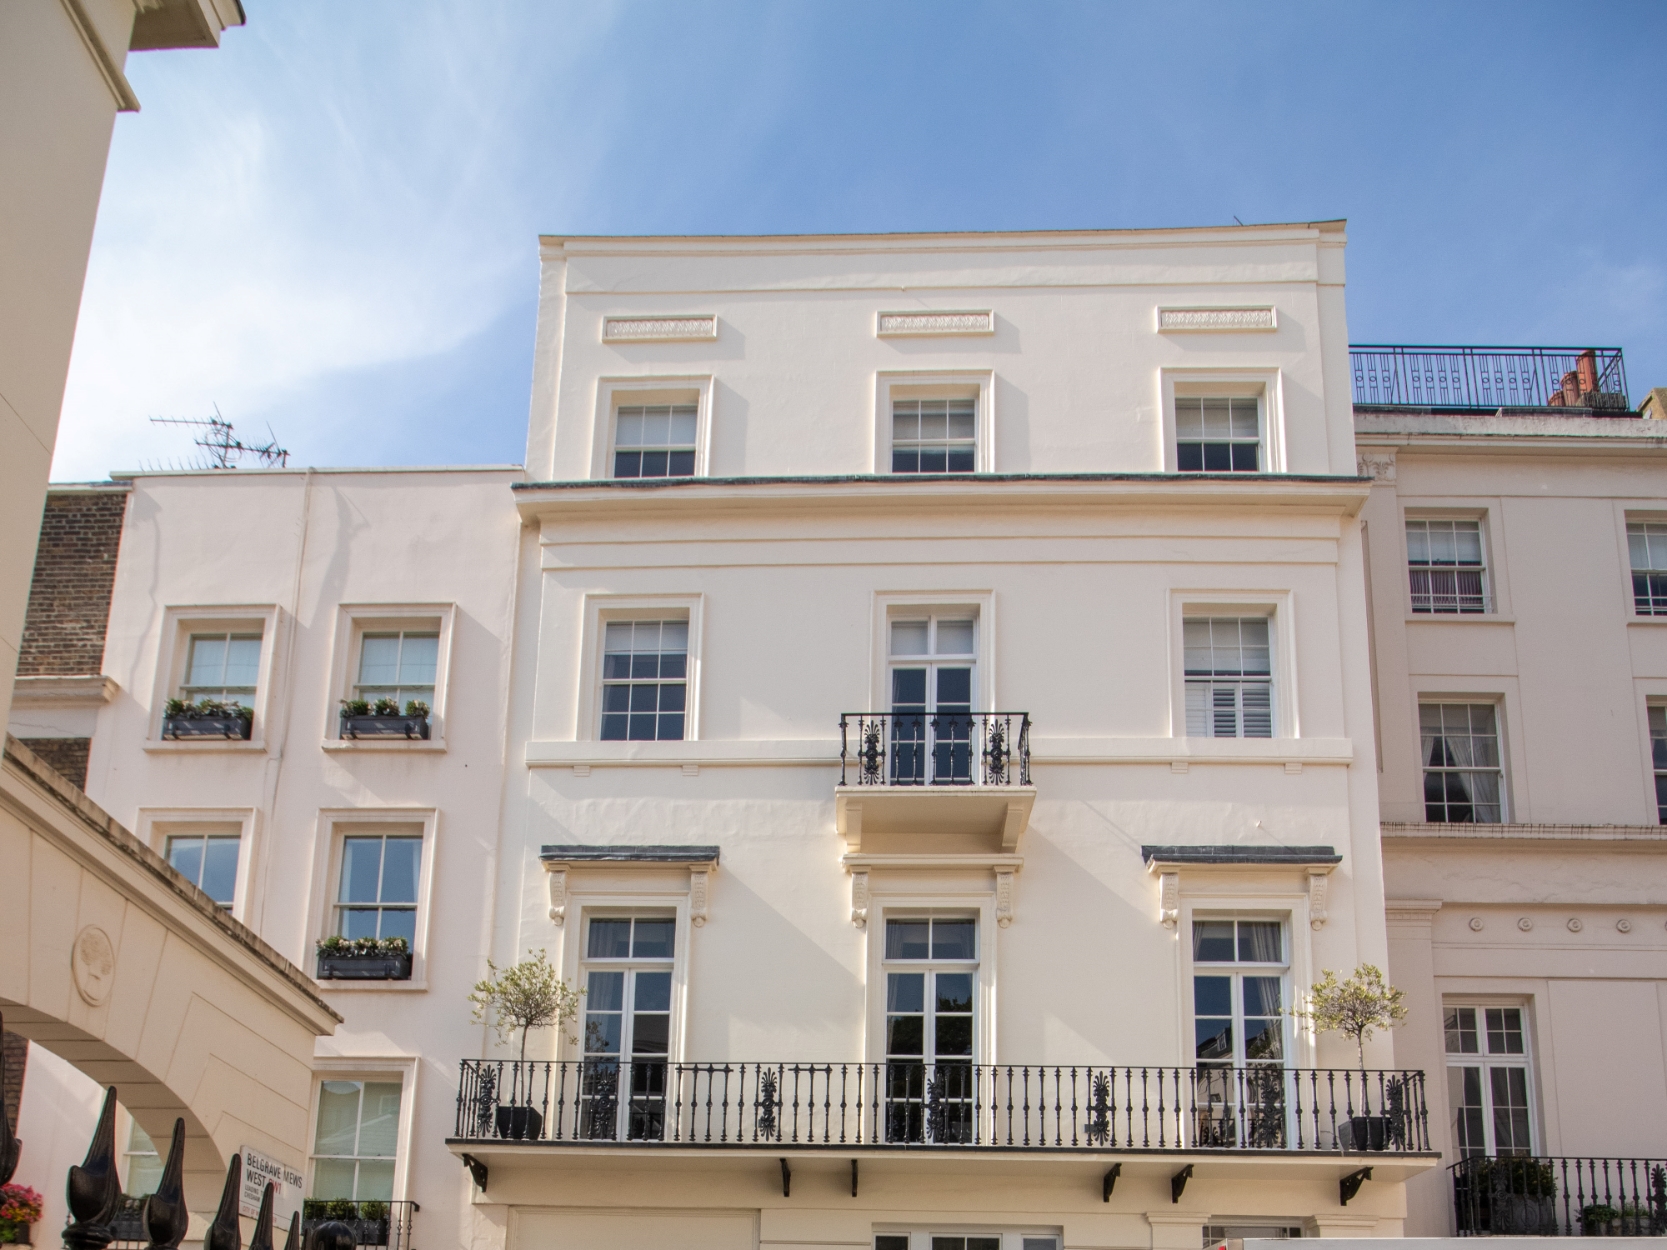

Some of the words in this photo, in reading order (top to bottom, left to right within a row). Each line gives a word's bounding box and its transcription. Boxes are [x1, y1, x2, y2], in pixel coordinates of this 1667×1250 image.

[246, 1169, 266, 1188] WEST
[247, 1153, 281, 1179] BELGRAVE
[283, 1169, 303, 1189] MEWS
